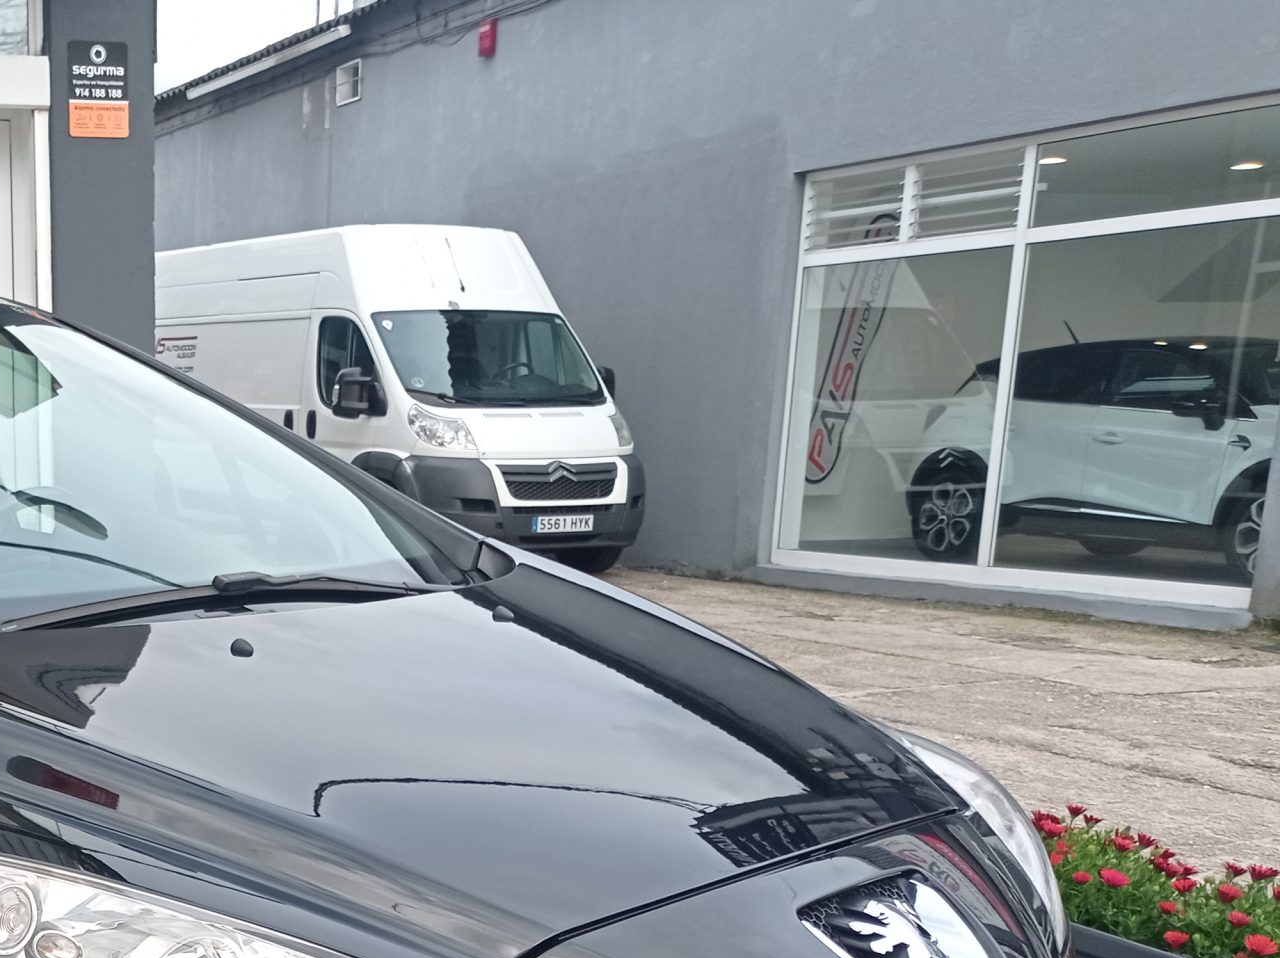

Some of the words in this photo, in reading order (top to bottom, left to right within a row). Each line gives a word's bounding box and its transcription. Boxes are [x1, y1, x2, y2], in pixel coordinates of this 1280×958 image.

[72, 65, 124, 78] segurma
[75, 88, 89, 97] 914
[92, 89, 106, 98] 188
[108, 89, 123, 98] 188
[808, 362, 855, 475] PAIS
[539, 518, 567, 530] 5561
[570, 517, 592, 529] HYK
